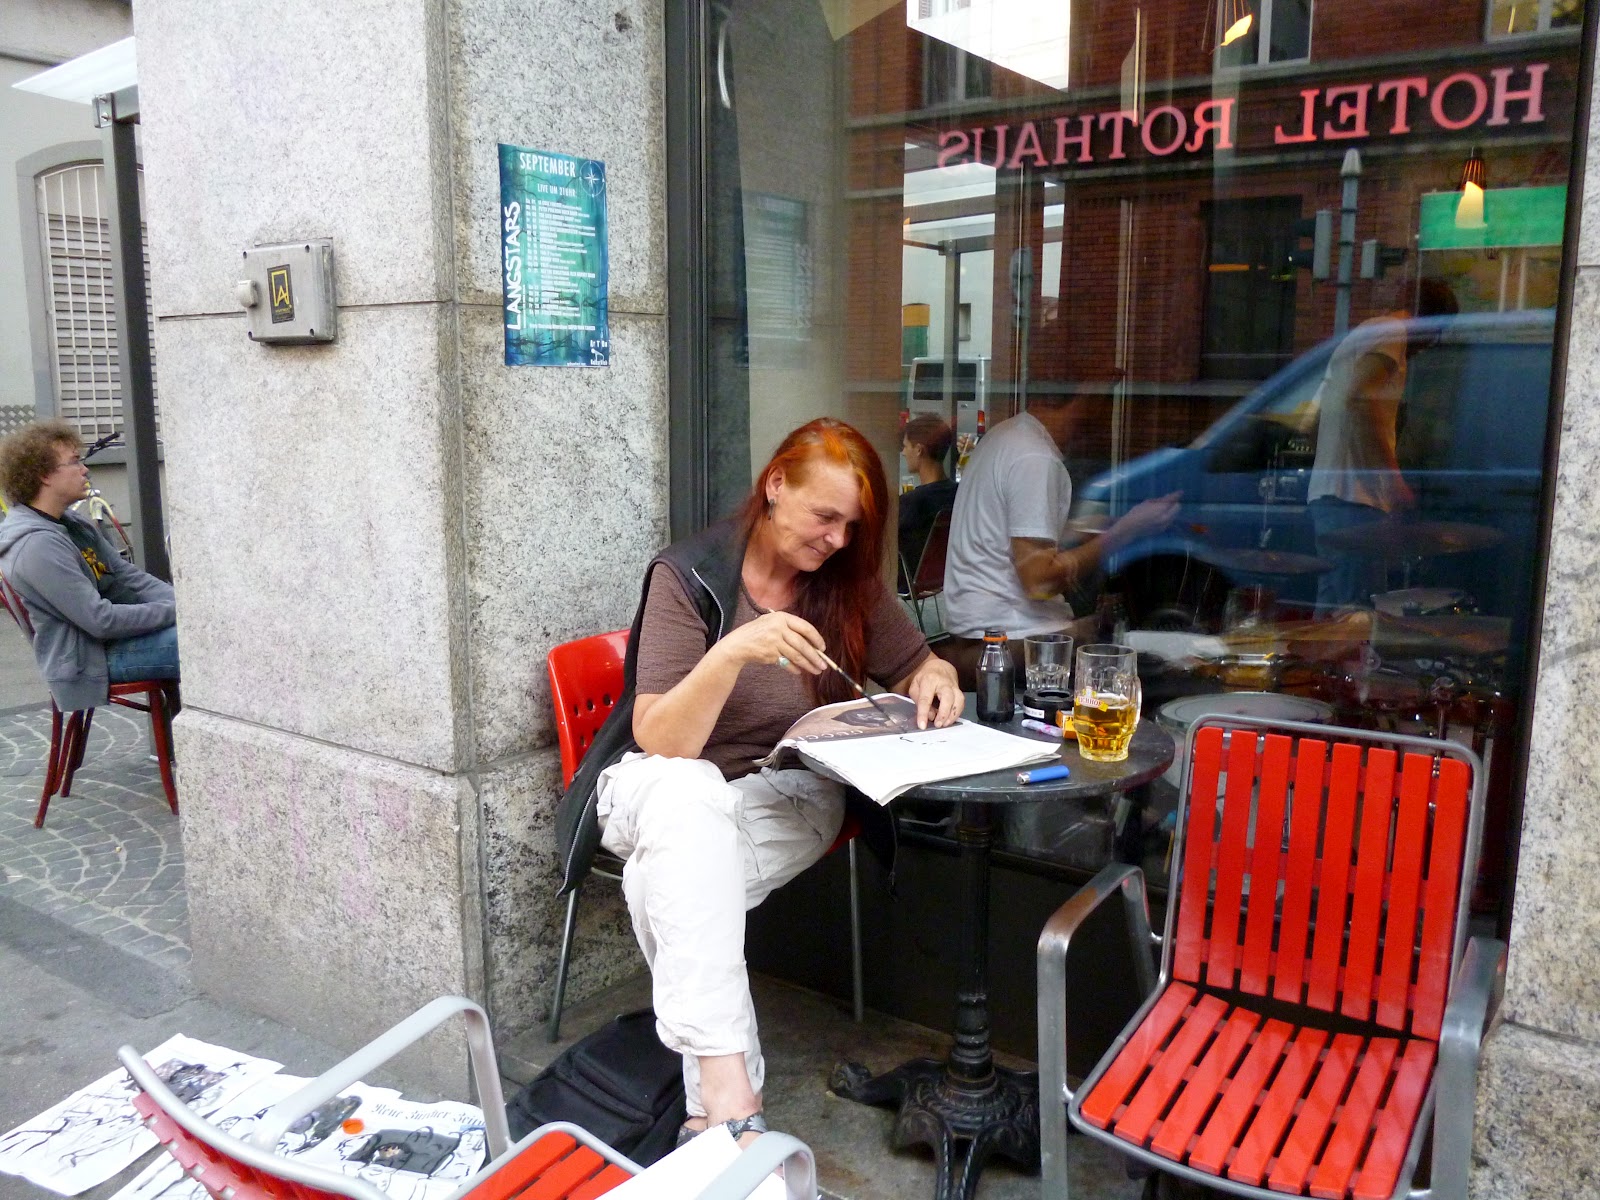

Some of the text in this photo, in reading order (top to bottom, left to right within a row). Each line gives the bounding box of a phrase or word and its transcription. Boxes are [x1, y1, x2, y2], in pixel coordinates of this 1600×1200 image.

[519, 152, 577, 178] SEPTEMBER
[537, 183, 549, 194] LIVE
[504, 201, 522, 331] LANGSTARS
[797, 729, 864, 742] GUCCI
